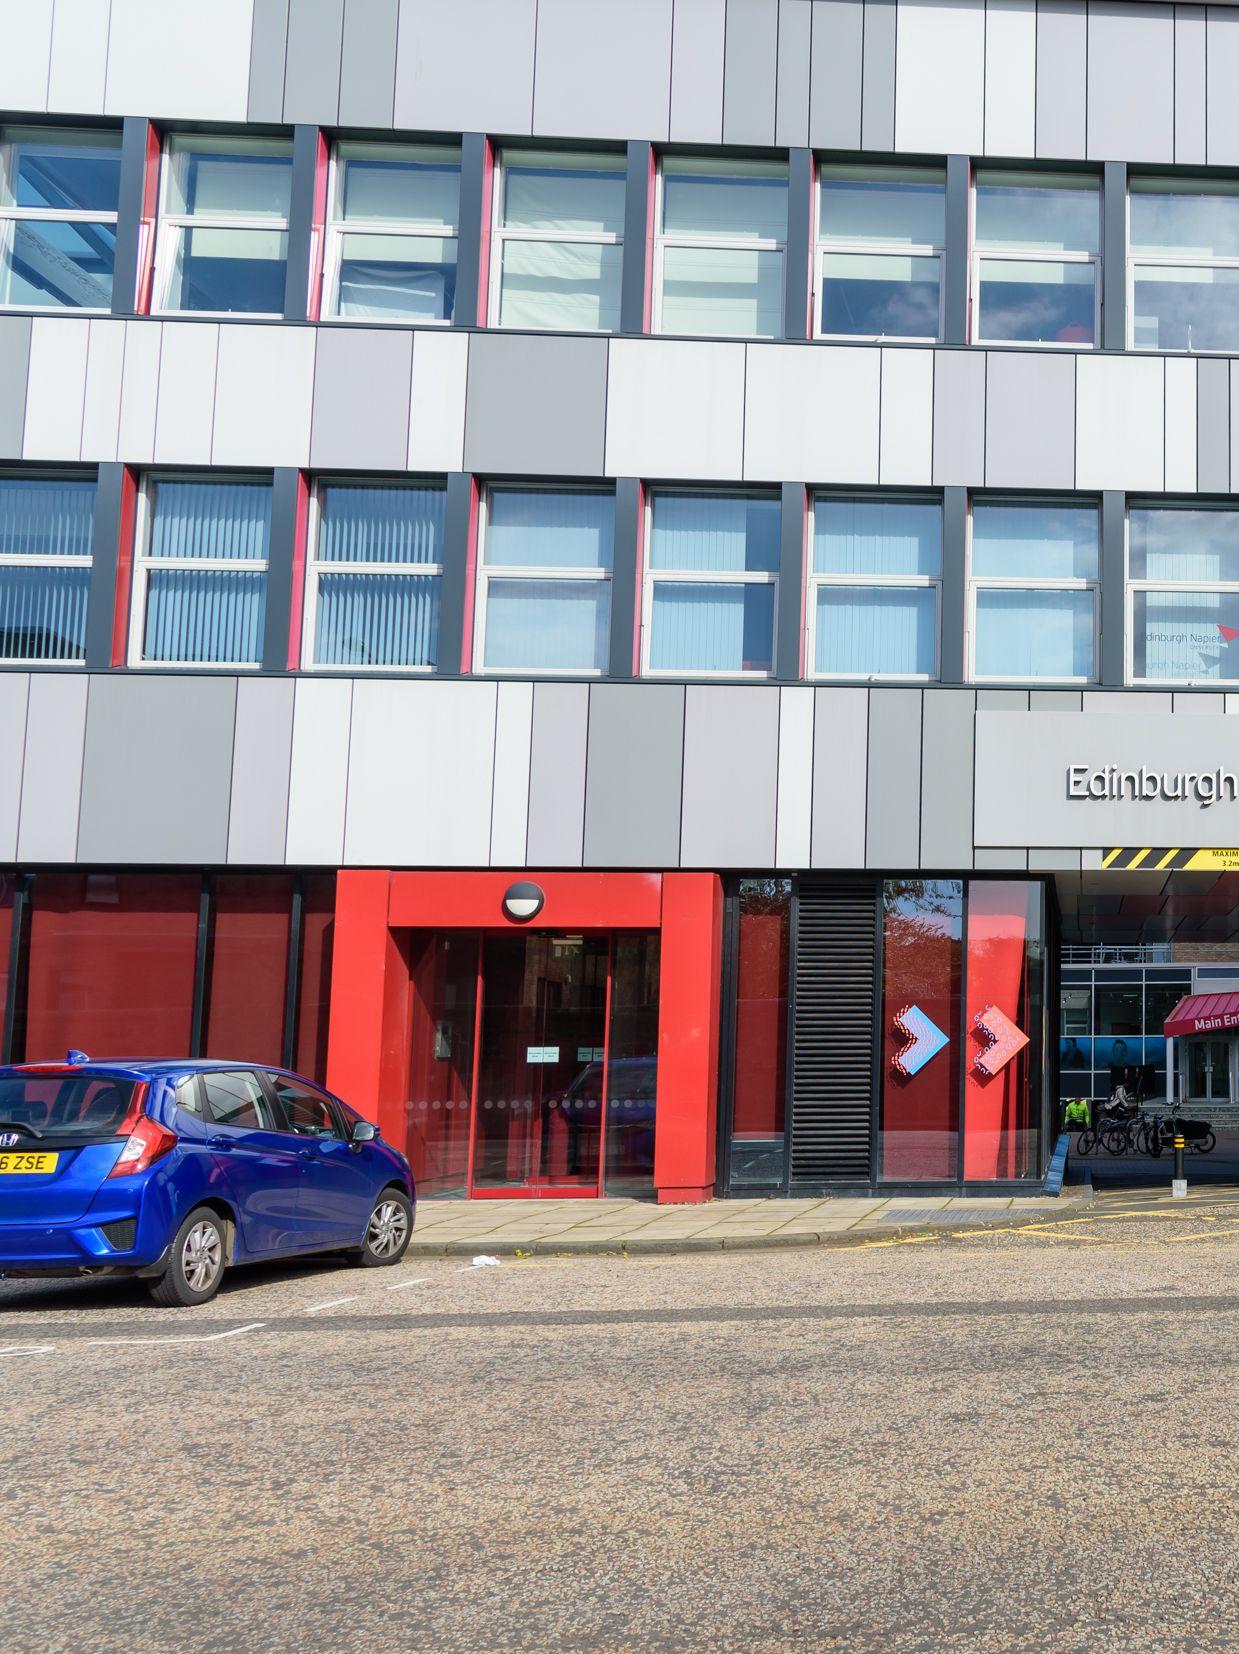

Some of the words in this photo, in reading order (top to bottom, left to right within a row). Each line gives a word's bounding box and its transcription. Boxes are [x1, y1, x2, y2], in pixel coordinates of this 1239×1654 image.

[1067, 763, 1239, 807] Edinburgh
[1195, 1017, 1221, 1030] Main
[13, 1155, 47, 1170] ZSE
